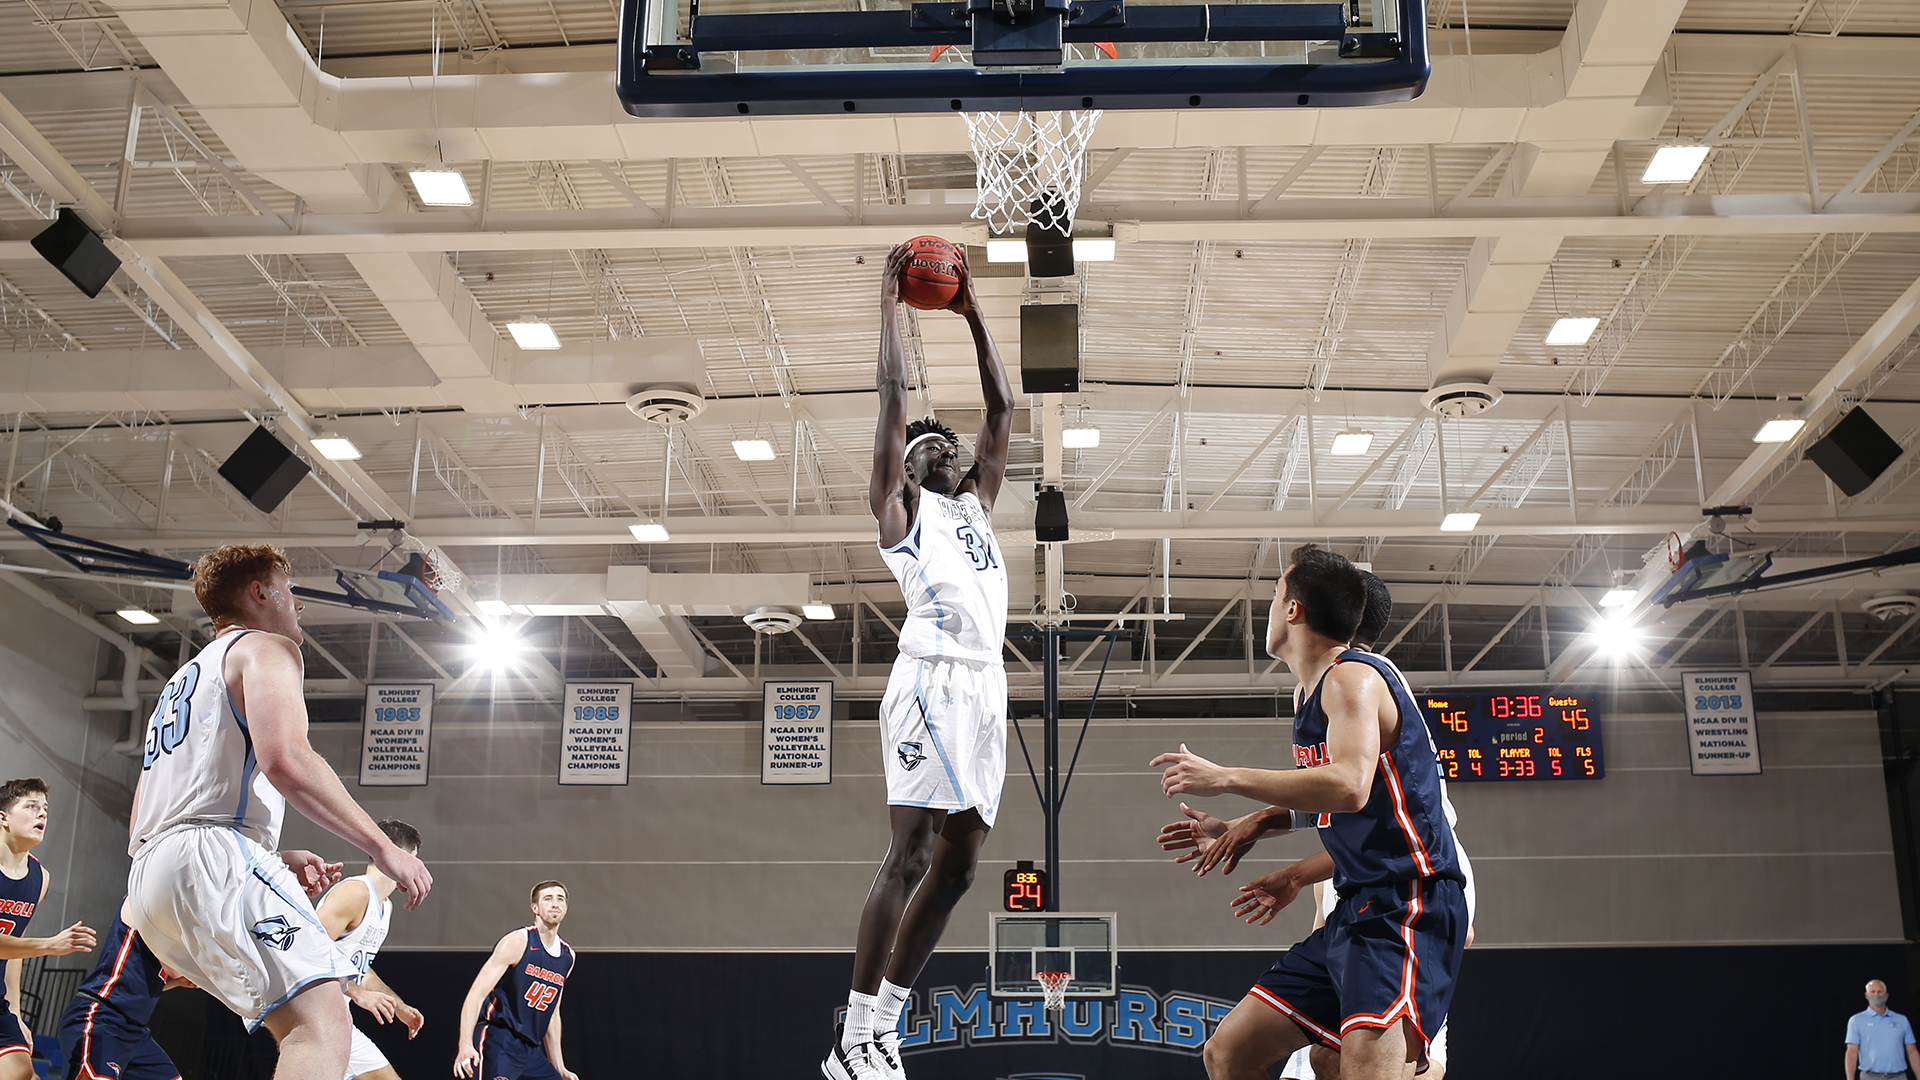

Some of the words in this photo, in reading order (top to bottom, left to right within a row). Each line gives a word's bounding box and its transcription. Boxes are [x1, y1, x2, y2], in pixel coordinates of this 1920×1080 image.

[910, 258, 959, 278] Wilson
[1428, 699, 1449, 709] Home
[1491, 696, 1542, 717] 13:36
[1548, 696, 1578, 706] Guests
[1695, 695, 1742, 710] 2013
[143, 661, 200, 771] 33
[374, 707, 420, 722] 1983
[573, 706, 620, 721] 1985
[774, 705, 820, 720] 1987
[1561, 708, 1589, 730] 45
[1441, 711, 1468, 732] 46
[1501, 732, 1528, 742] period
[1534, 727, 1544, 743] 2
[1695, 728, 1748, 736] WRESTLING
[1700, 740, 1746, 748] NATIONAL
[1440, 749, 1456, 759] FLS
[1467, 748, 1483, 759] TOL
[1500, 748, 1531, 758] PLAYER
[1547, 747, 1563, 757] TOL
[1575, 747, 1592, 757] FLS
[1698, 752, 1751, 760] RUNNER-UP
[567, 762, 620, 770] CHAMPIONS
[1448, 761, 1459, 777] 2
[1470, 762, 1482, 776] 4
[1499, 760, 1535, 777] 3-33
[1550, 760, 1562, 776] 5
[1583, 759, 1595, 775] 5
[1009, 883, 1041, 908] 24
[524, 981, 558, 1011] 42
[839, 986, 1236, 1050] LMHURS
